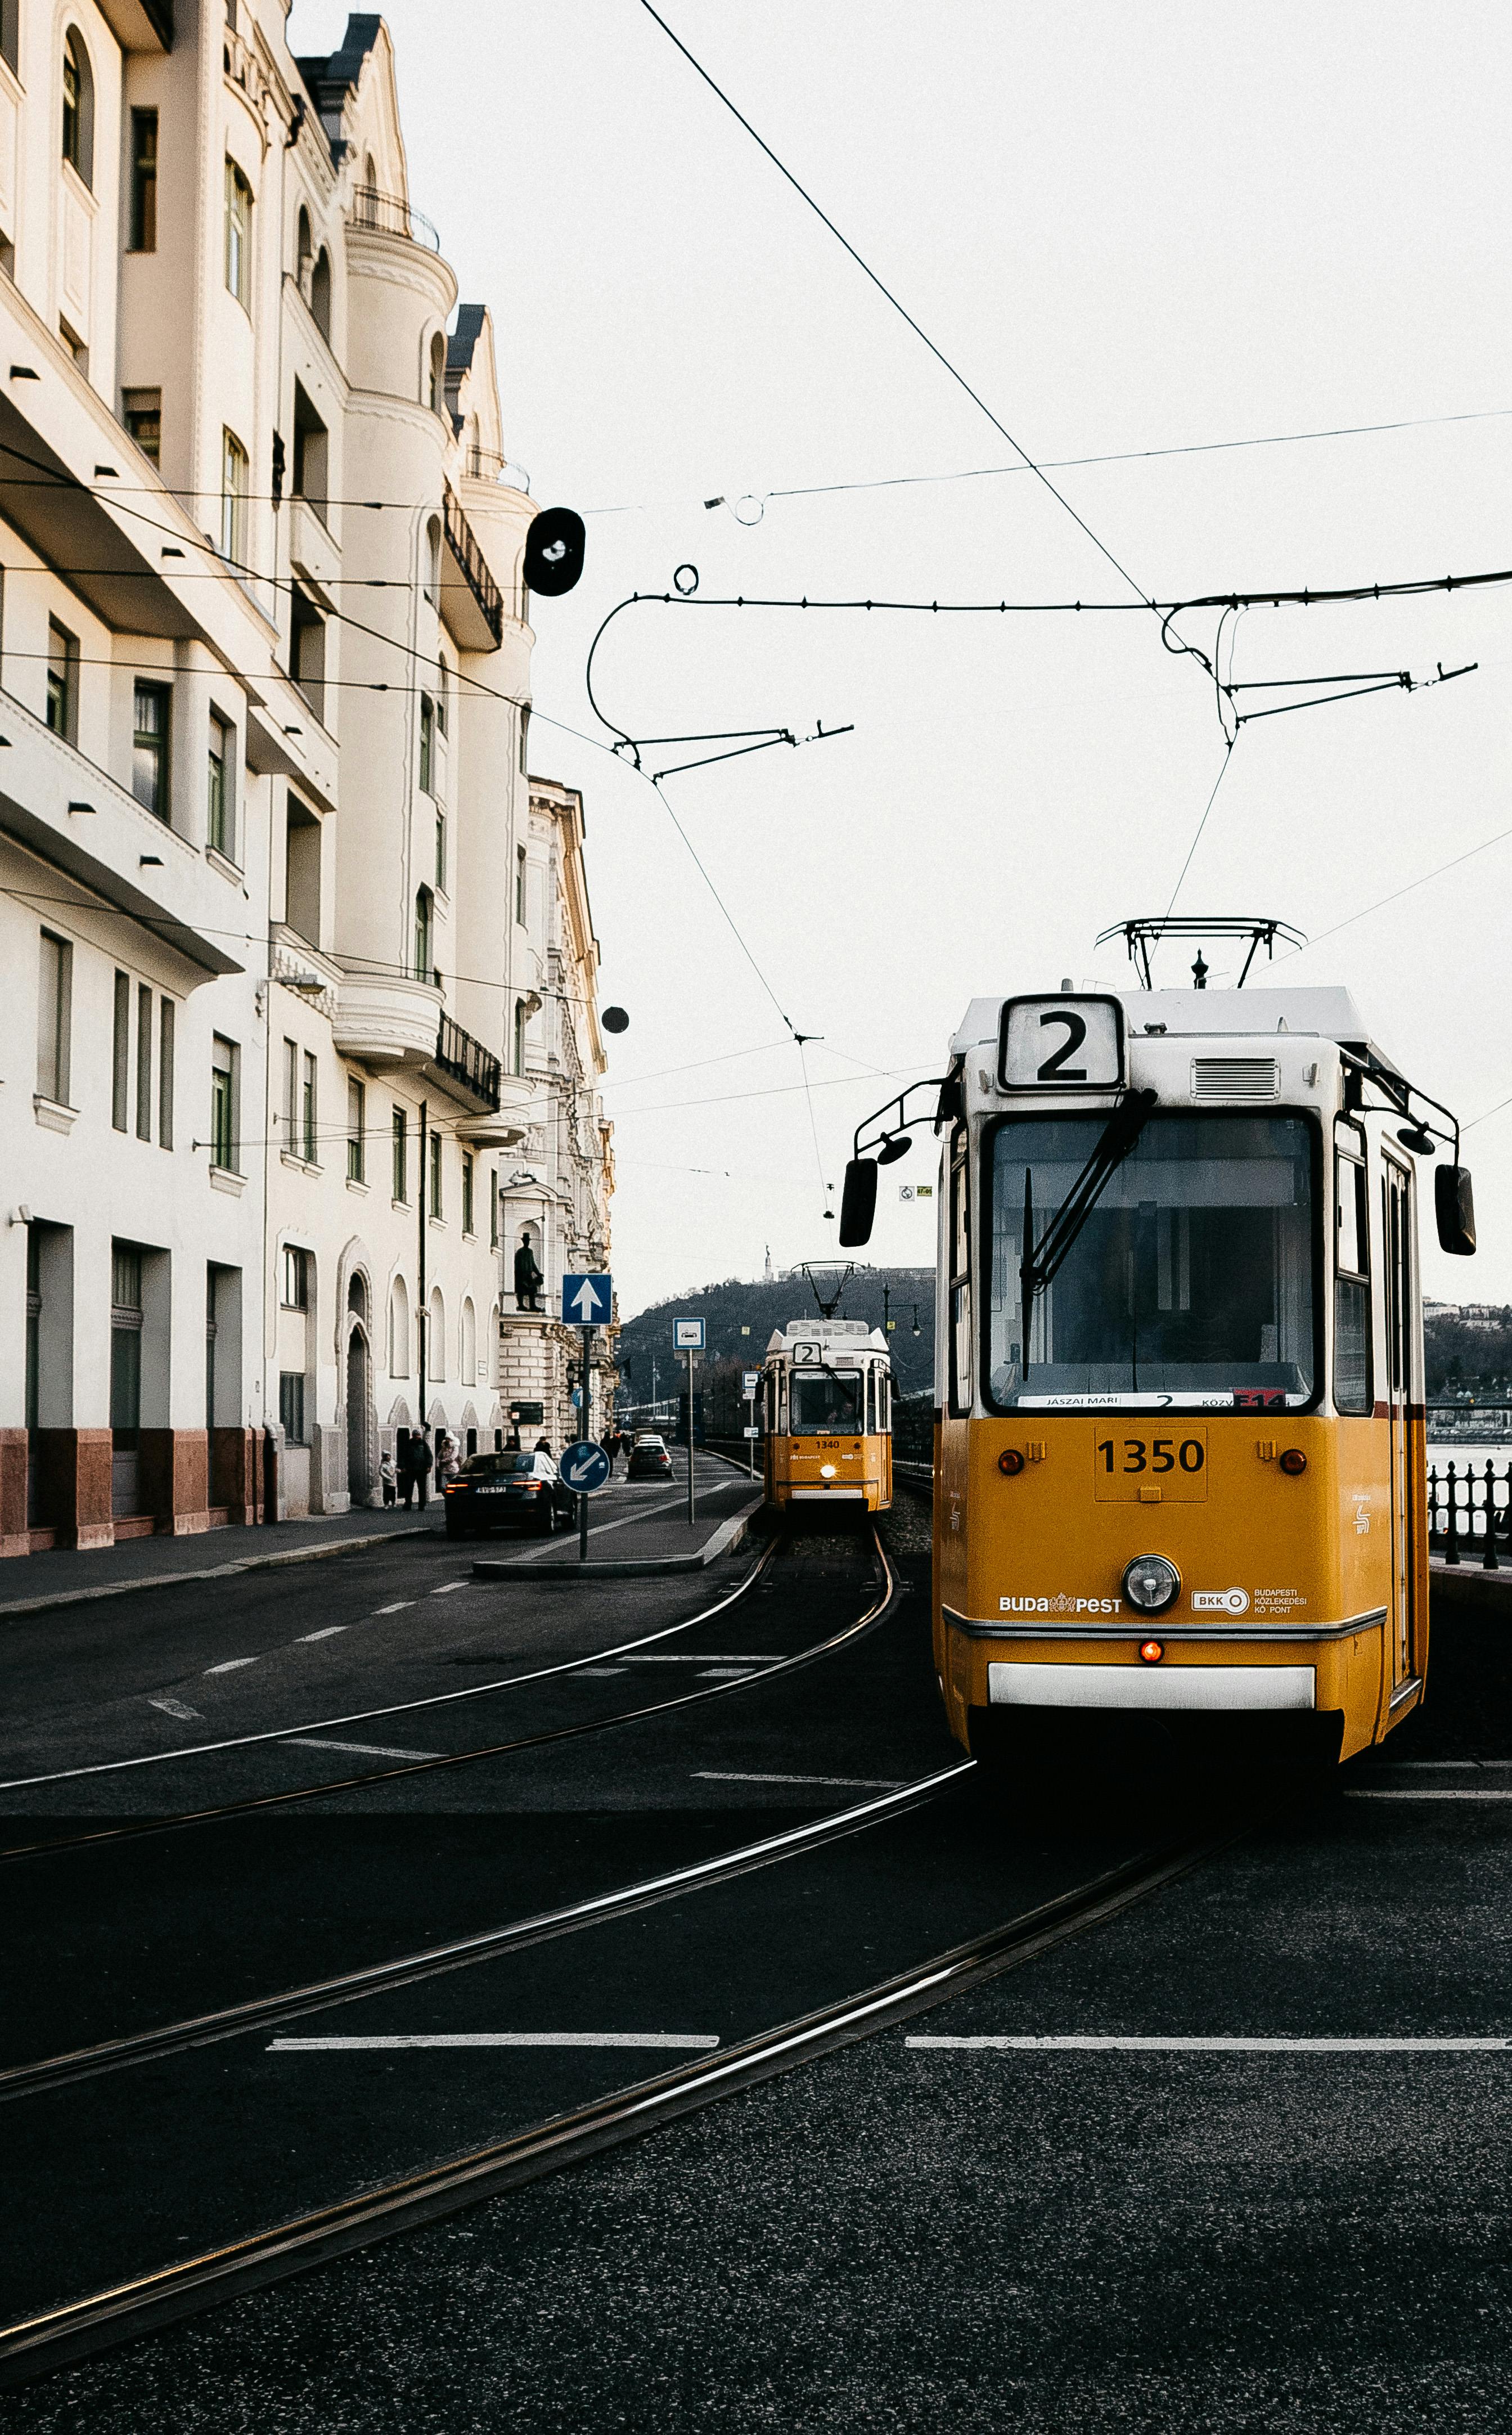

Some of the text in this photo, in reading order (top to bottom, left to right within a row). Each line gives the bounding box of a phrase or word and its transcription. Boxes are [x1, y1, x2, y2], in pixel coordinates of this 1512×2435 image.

[1037, 1010, 1087, 1081] 2
[802, 1346, 813, 1362] 2
[1156, 1395, 1173, 1407] 2
[1097, 1439, 1204, 1473] 1350
[1199, 1597, 1223, 1605] BKK
[1254, 1597, 1307, 1605] KÖZLEKEDÉSI
